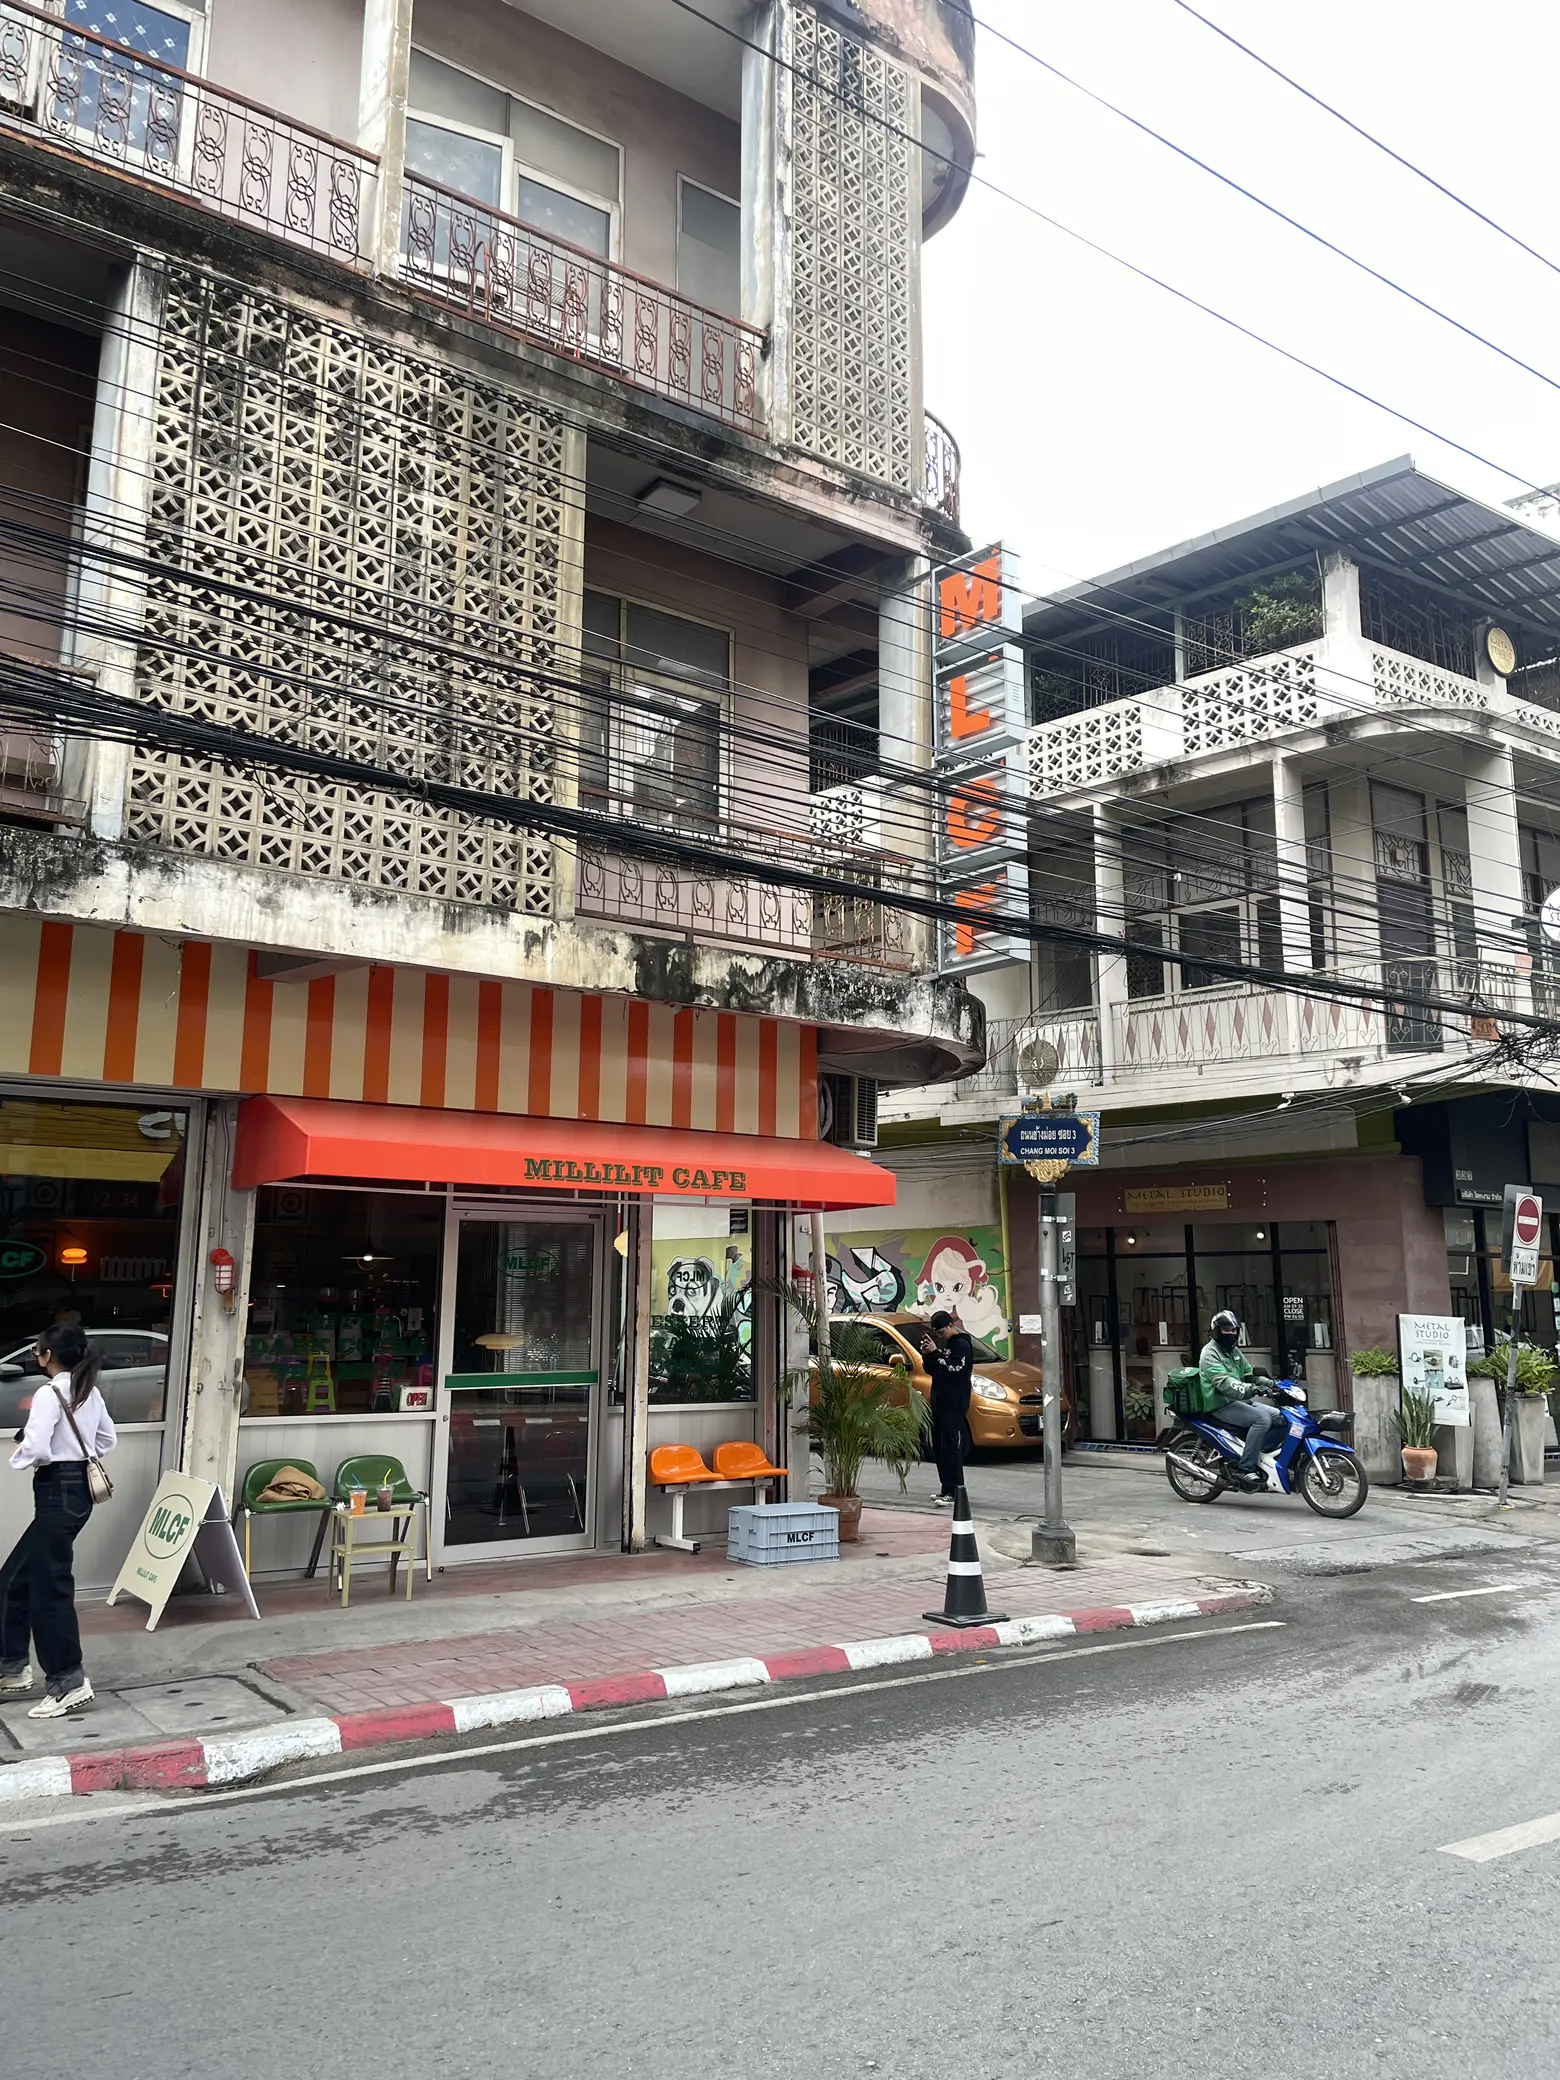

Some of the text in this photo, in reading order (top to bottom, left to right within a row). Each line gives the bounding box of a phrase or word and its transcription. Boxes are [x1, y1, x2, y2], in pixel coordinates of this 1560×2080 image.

[1020, 1147, 1044, 1155] CHANG
[1044, 1147, 1058, 1155] MOI
[1058, 1147, 1070, 1155] SOI
[524, 1158, 746, 1190] MILLILIT CAFE
[1127, 1187, 1225, 1200] METAL STUDIO
[1414, 1322, 1450, 1331] METAL
[1416, 1330, 1449, 1339] STUDIO
[406, 1392, 428, 1406] OPEN
[149, 1507, 190, 1545] MLCF
[787, 1532, 815, 1543] MLCF
